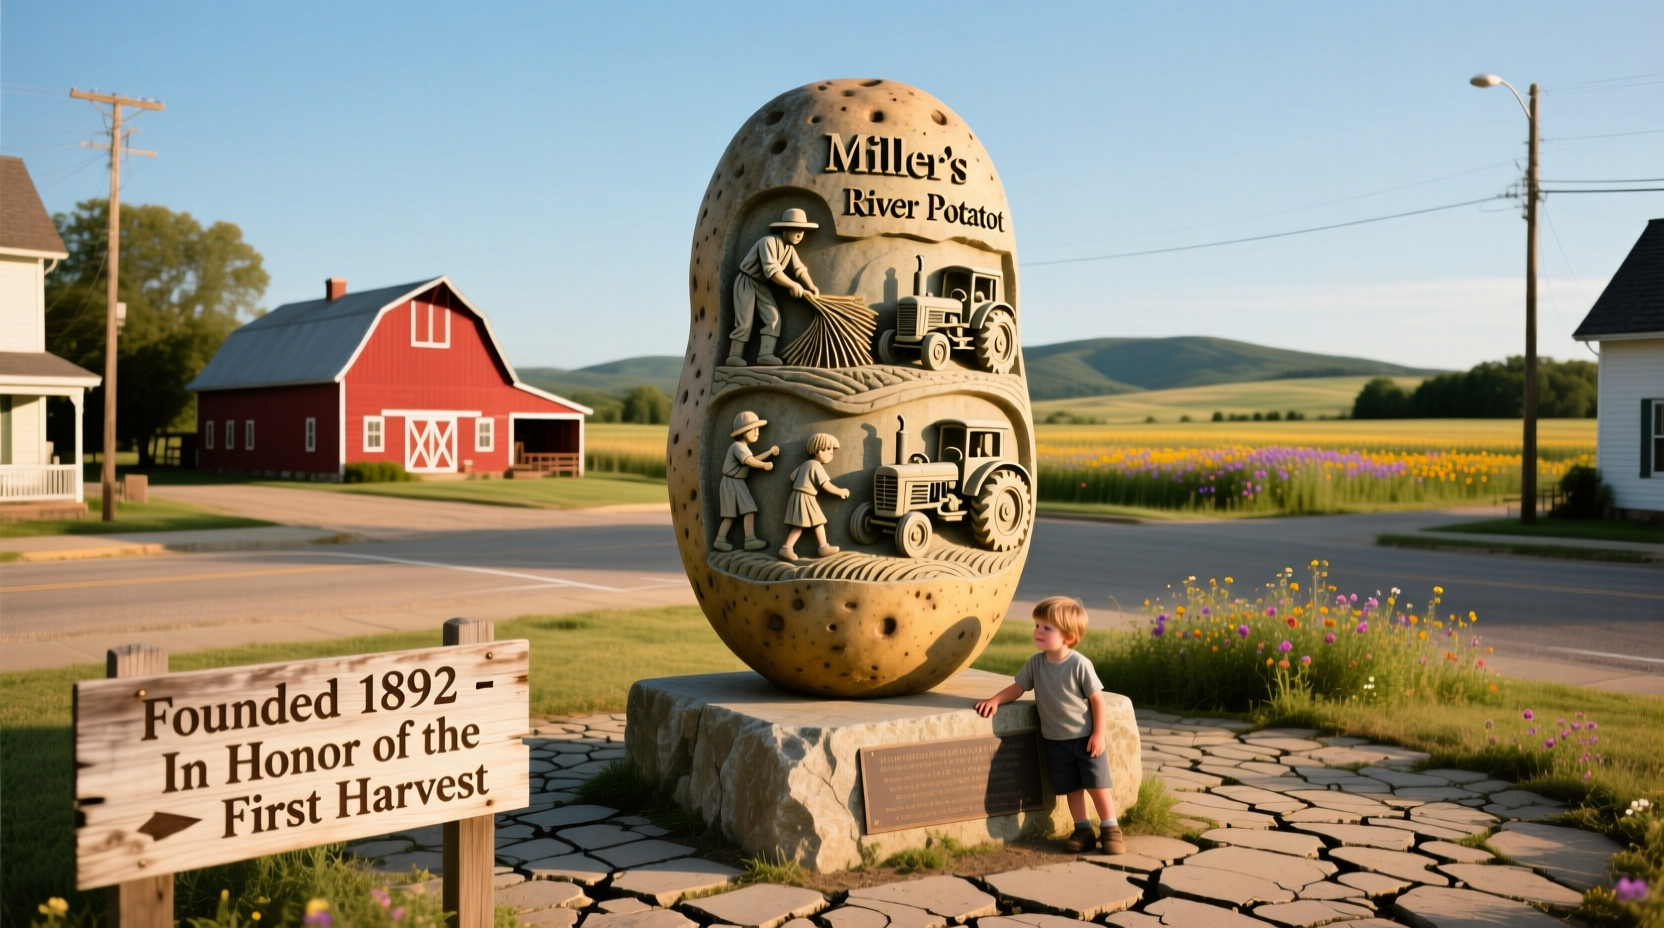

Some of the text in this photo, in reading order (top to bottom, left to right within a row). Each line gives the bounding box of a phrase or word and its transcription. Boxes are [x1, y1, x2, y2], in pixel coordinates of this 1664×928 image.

[824, 133, 967, 185] Miller's
[842, 188, 1006, 233] River Potatot
[140, 677, 341, 741] Founded
[359, 666, 458, 716] 1892
[161, 716, 481, 794] In Honor of the
[221, 764, 490, 839] First Harvest
